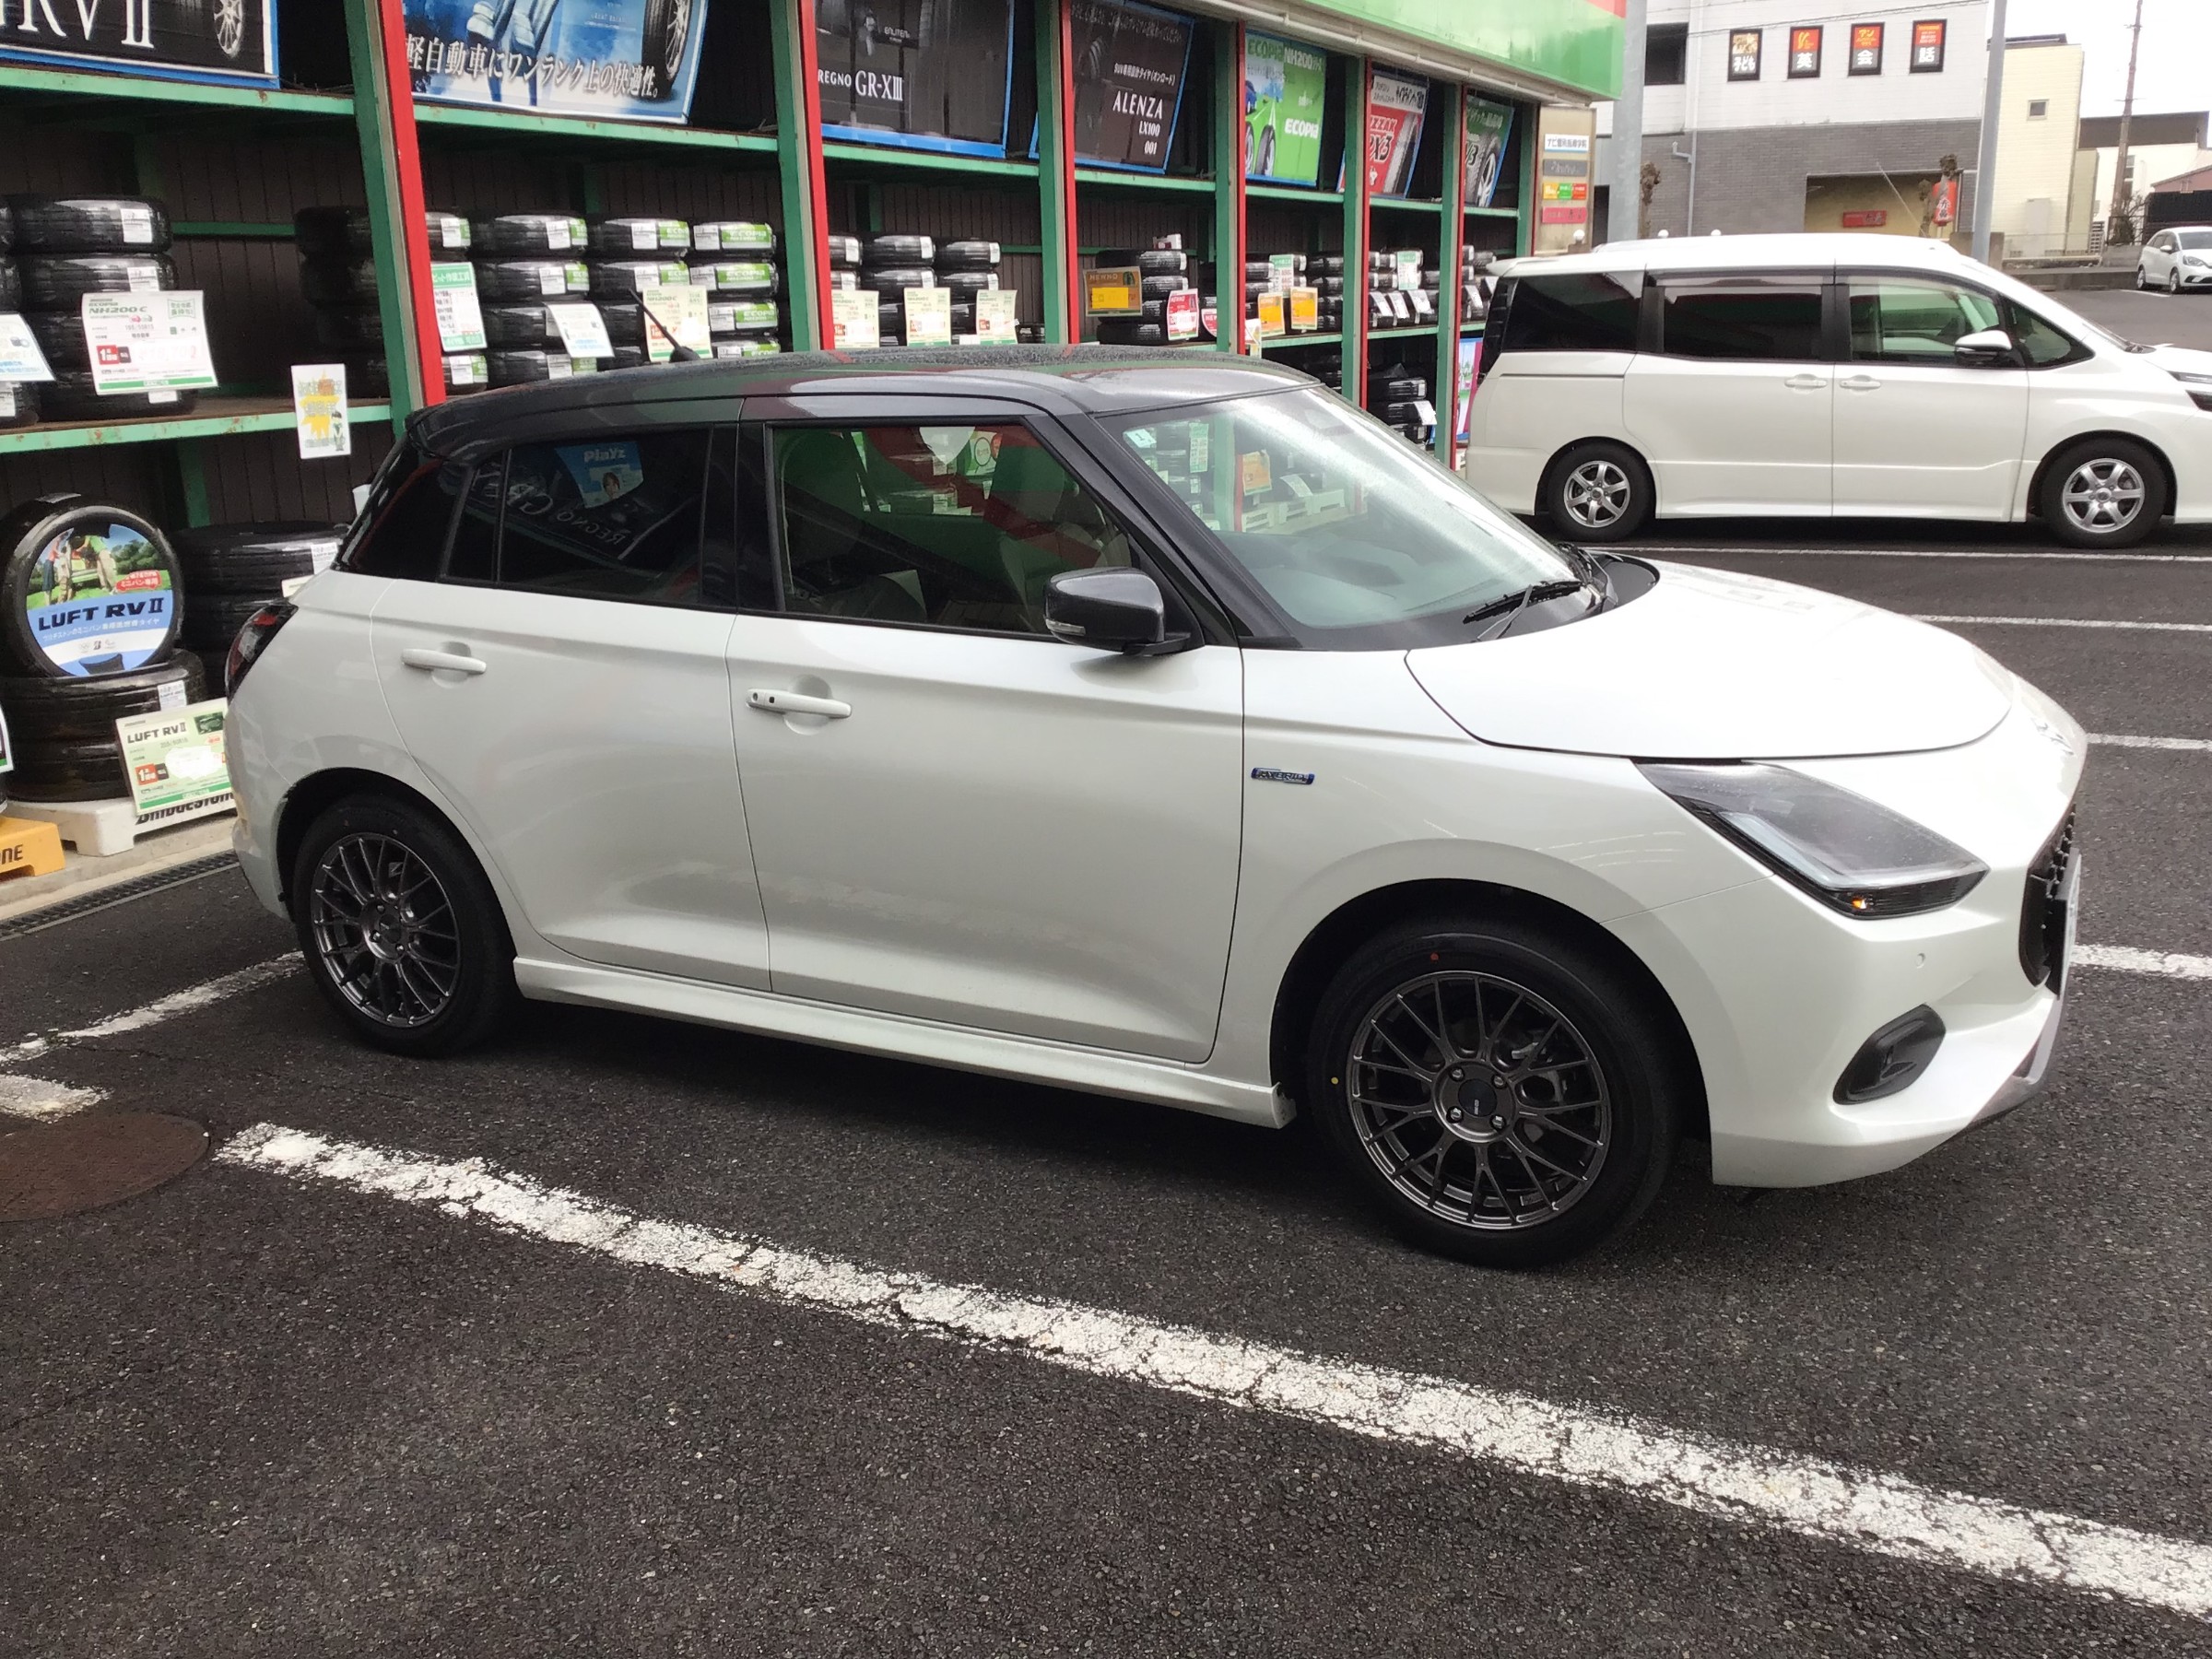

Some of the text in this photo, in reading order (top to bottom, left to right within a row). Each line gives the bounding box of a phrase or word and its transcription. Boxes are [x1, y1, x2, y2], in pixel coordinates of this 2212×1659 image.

[1734, 47, 1936, 71] 子ども 英 会 話
[818, 69, 853, 88] REGNO
[1112, 90, 1163, 120] ALENZA
[1138, 120, 1161, 137] LX100
[1144, 140, 1158, 155] 001
[38, 606, 100, 631] LUFT
[127, 729, 159, 744] LUFT
